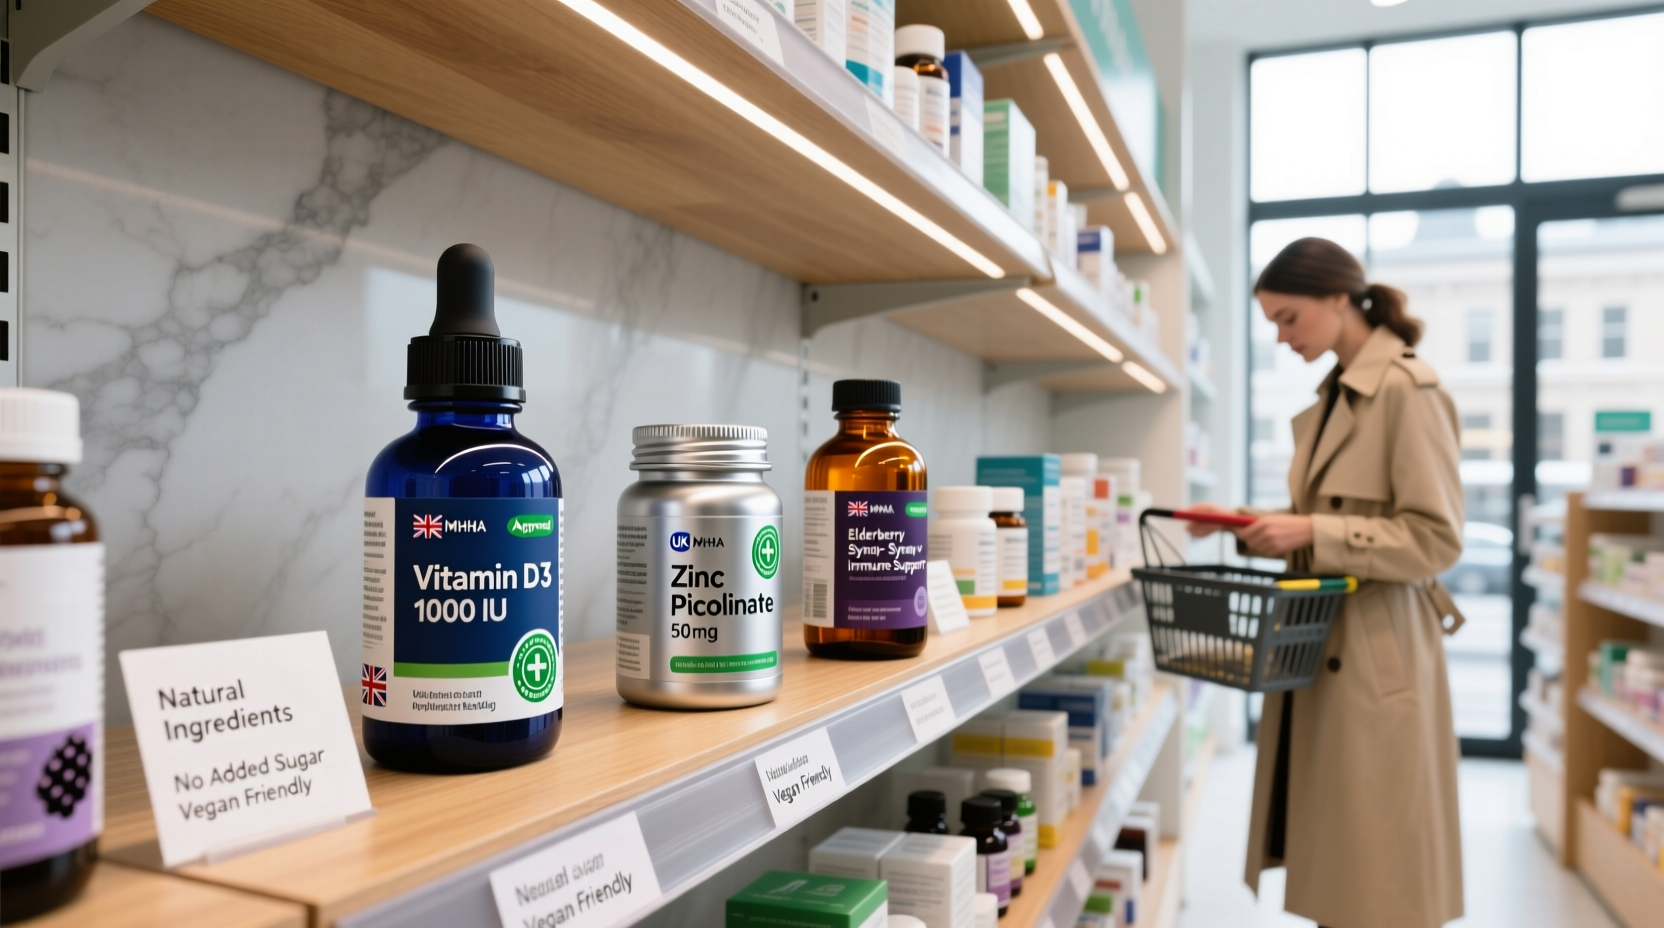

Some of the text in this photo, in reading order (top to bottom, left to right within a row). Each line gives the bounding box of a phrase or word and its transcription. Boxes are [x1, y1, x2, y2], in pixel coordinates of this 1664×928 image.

[445, 520, 486, 532] MHHA
[672, 535, 689, 548] UK
[413, 562, 552, 590] Vitamin D3
[671, 564, 725, 588] Zinc
[414, 598, 507, 623] 1000 IU
[671, 593, 774, 616] Picolinate
[158, 679, 245, 710] Natural
[164, 705, 293, 743] Ingredients
[174, 749, 325, 793] No Added Sugar
[178, 775, 312, 821] Vegan Friendly
[576, 871, 632, 913] Friendly
